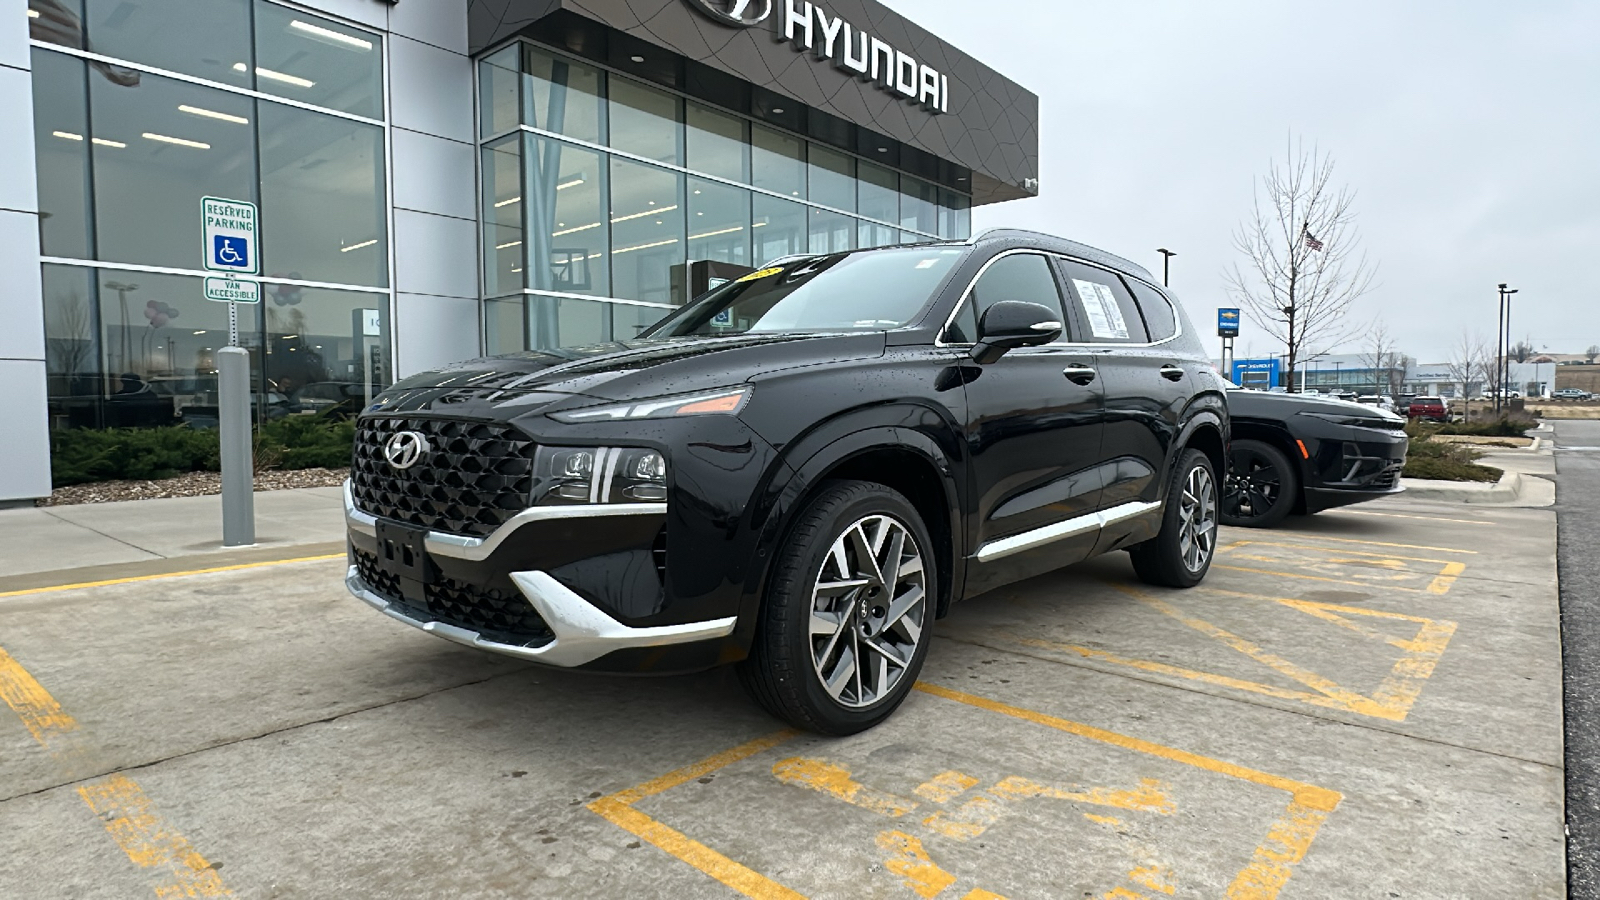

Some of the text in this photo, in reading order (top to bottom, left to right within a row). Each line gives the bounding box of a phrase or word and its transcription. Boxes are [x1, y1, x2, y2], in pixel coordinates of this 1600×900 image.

[785, 0, 948, 113] HYUNDAI
[208, 204, 251, 219] RESERVED
[208, 217, 252, 231] PARKING
[209, 289, 255, 299] ACCESSIBLE
